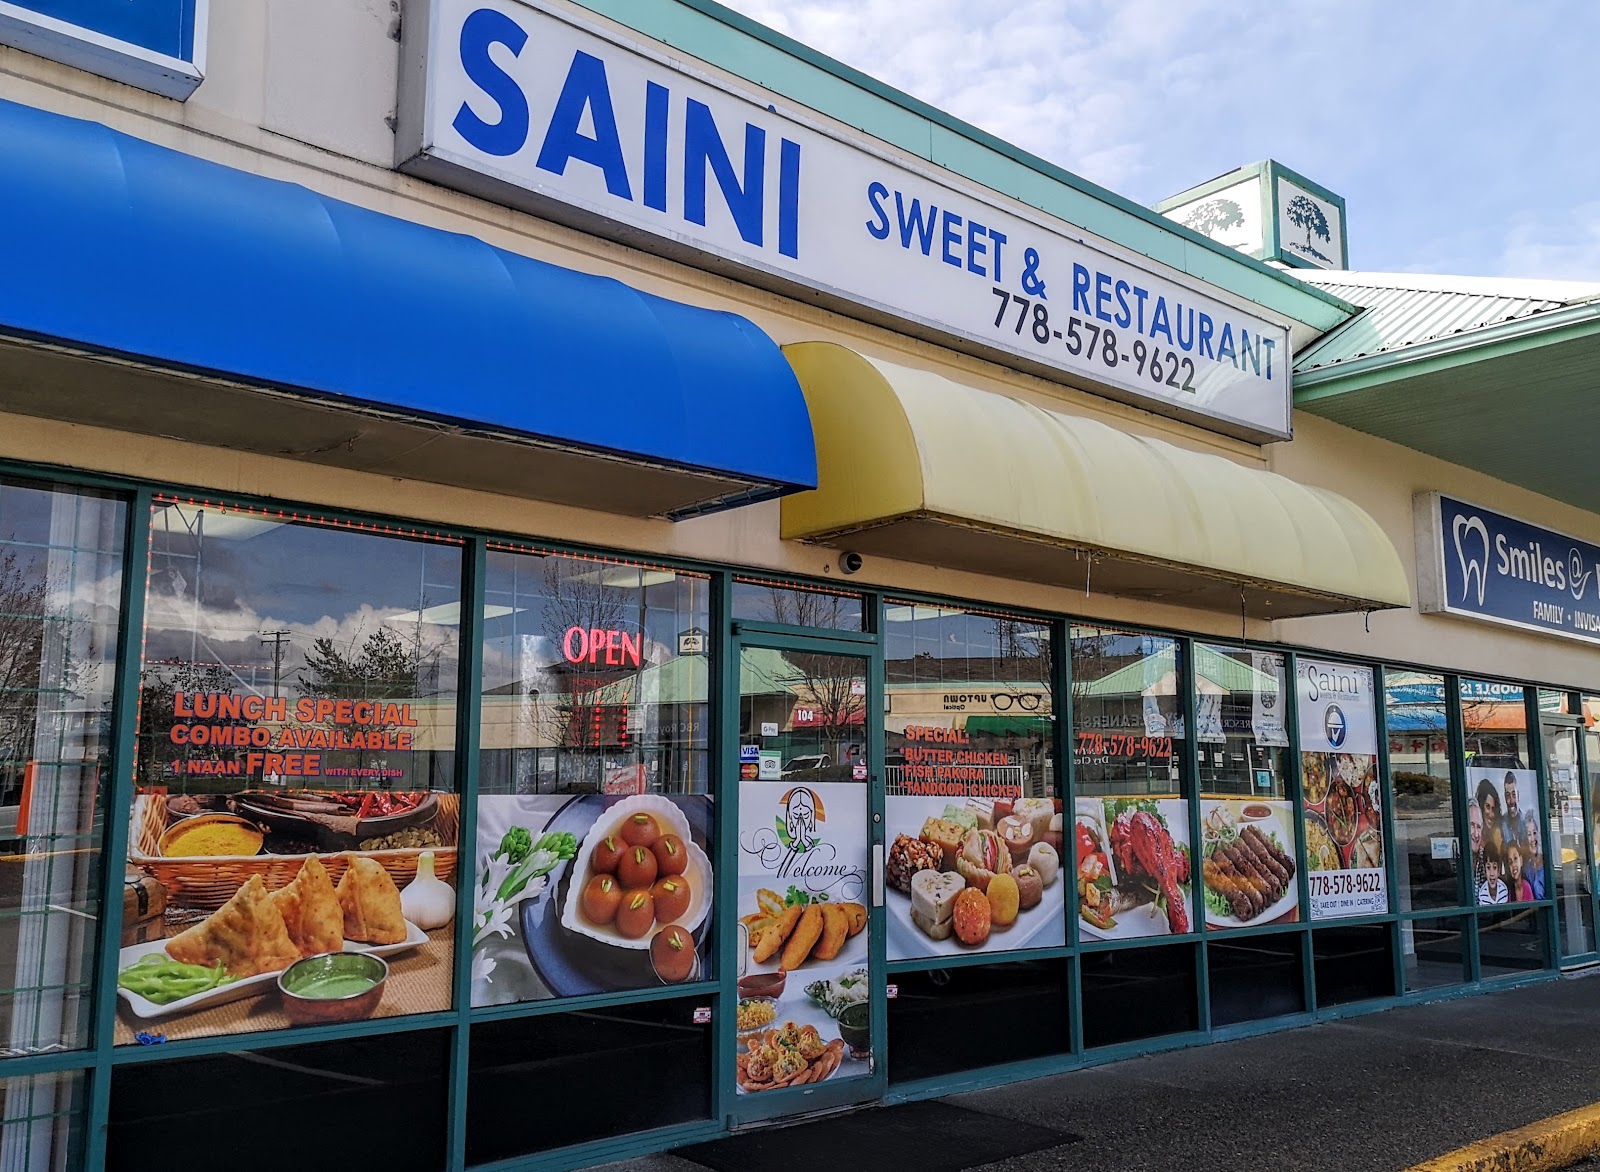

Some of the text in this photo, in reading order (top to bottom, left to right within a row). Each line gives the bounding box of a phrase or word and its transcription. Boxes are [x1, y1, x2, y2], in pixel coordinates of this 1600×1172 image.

[452, 8, 800, 260] SAINI
[866, 181, 1276, 381] SWEET & RESTAURANT
[992, 287, 1197, 394] 778-578-9622
[1495, 533, 1566, 591] Smiles
[1533, 600, 1564, 625] FAMILY
[563, 625, 641, 667] OPEN
[1308, 665, 1359, 702] Saini
[174, 691, 418, 727] LUNCH SPECIAL
[170, 724, 413, 751] COMBO AVAILABLE
[905, 725, 970, 744] SPECIAL:
[1078, 732, 1173, 758] 778-578-9622
[742, 747, 759, 755] VISA
[956, 751, 1009, 765] CHICKEN
[171, 753, 403, 778] 1 NAAN FREE WITH EVERY DISH
[936, 766, 985, 781] PAKORA
[970, 783, 1022, 798] CHICKEN
[1309, 872, 1381, 896] 778-578-9622
